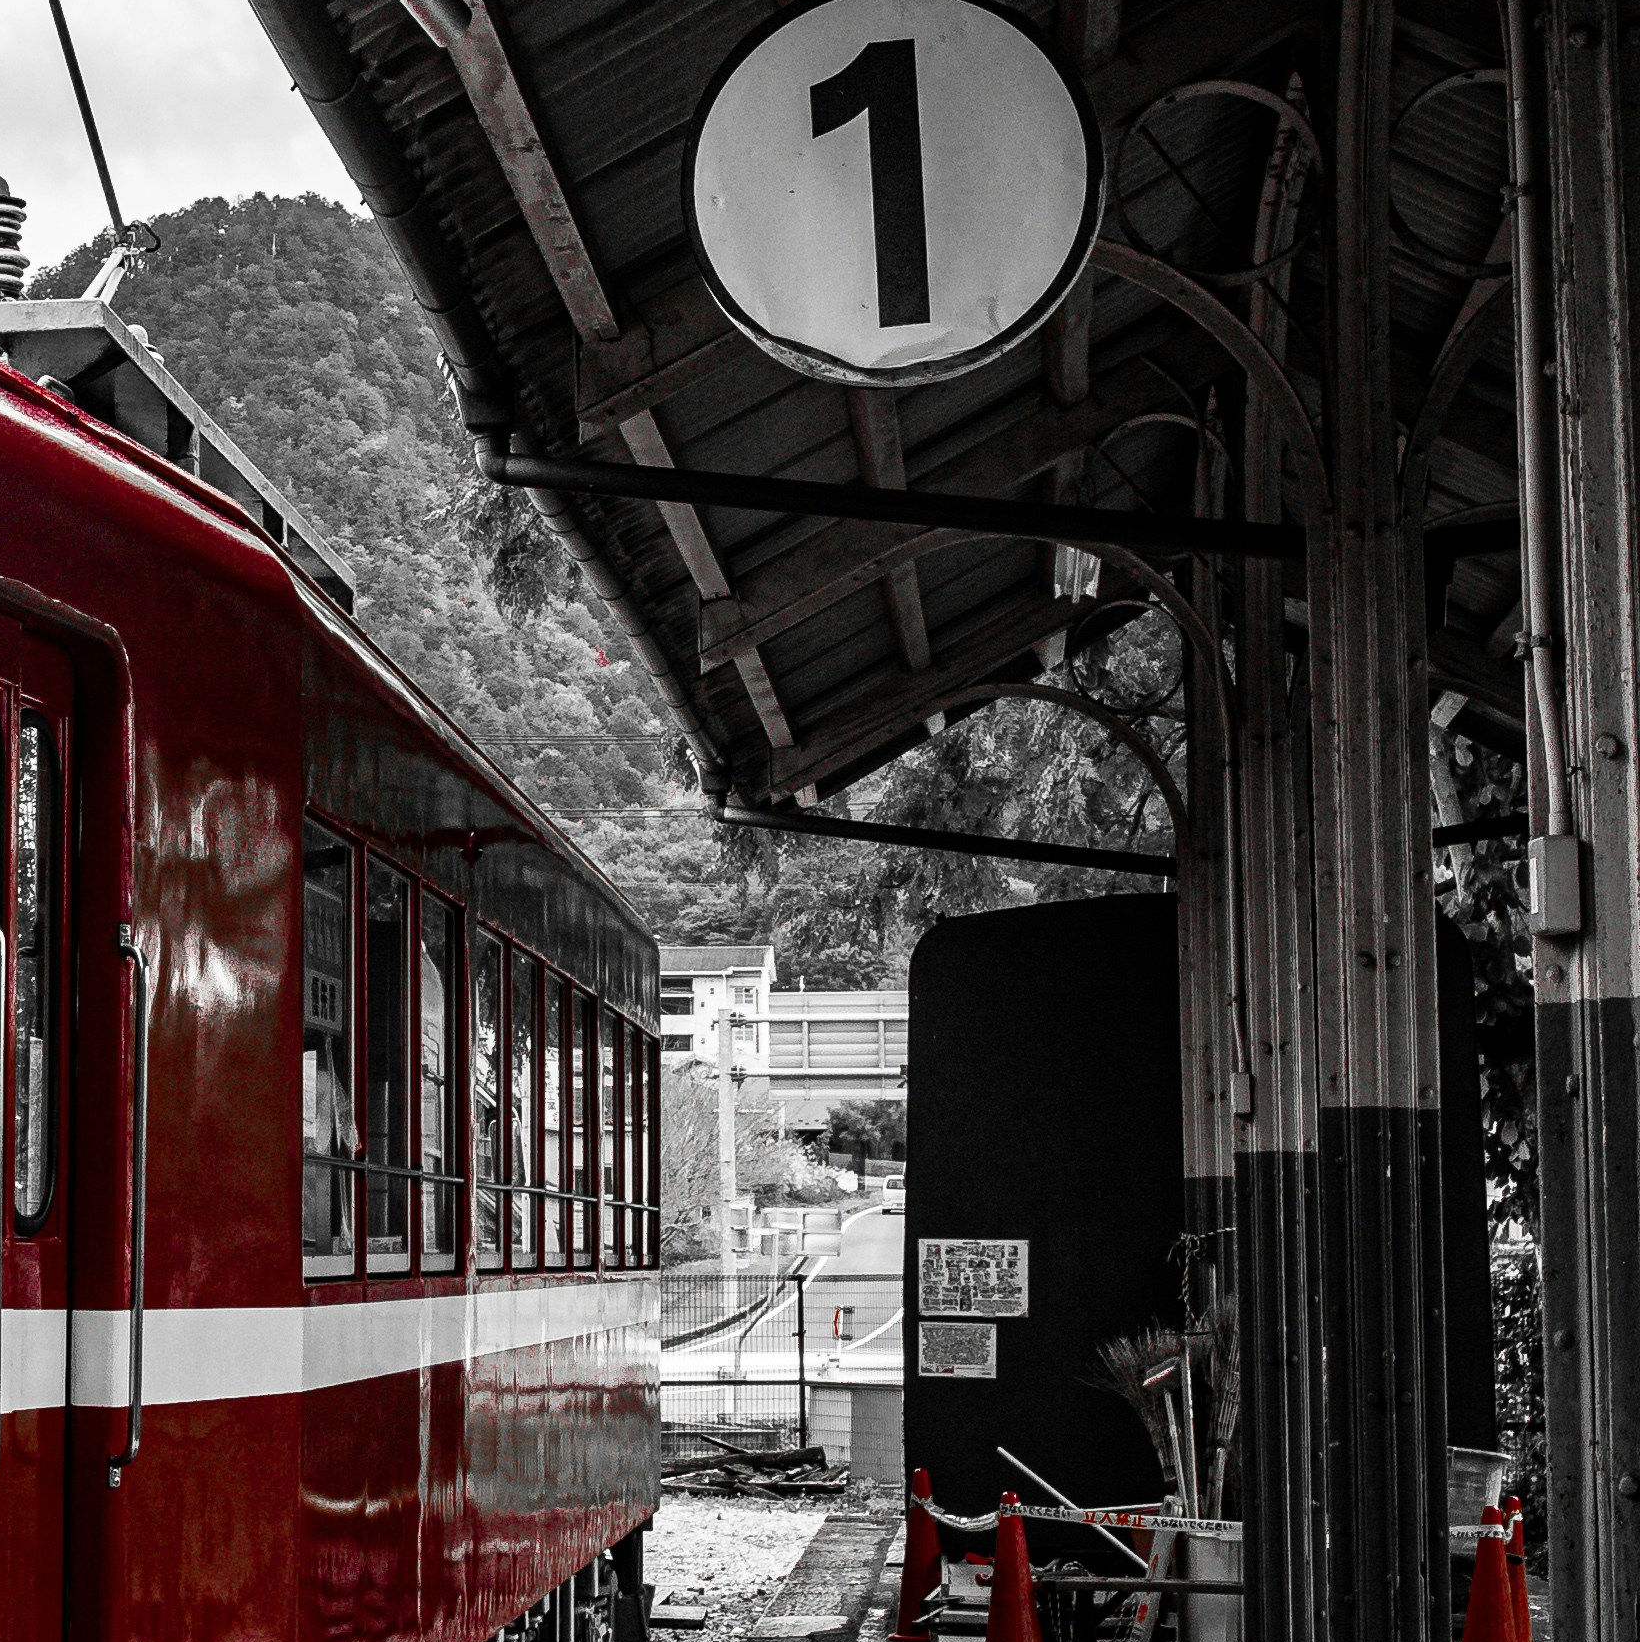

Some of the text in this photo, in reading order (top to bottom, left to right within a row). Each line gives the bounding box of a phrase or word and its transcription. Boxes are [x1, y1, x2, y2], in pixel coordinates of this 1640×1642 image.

[809, 38, 931, 329] 1
[1082, 1511, 1148, 1528] 立入禁止
